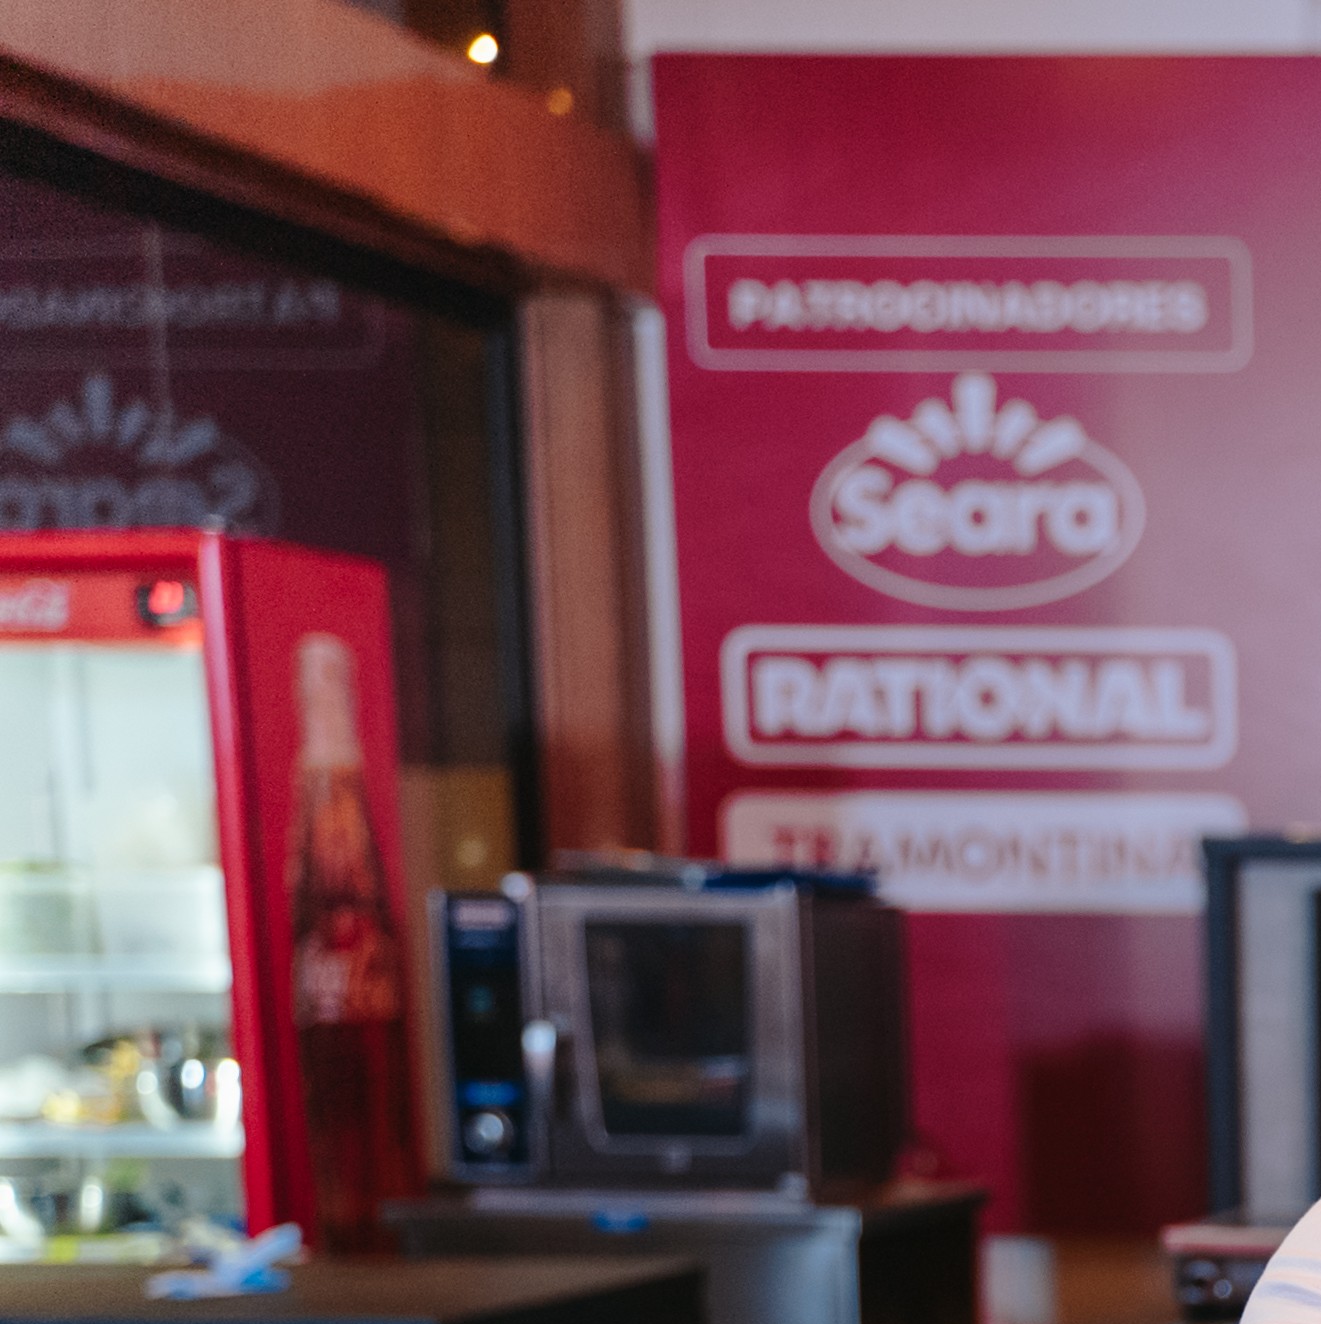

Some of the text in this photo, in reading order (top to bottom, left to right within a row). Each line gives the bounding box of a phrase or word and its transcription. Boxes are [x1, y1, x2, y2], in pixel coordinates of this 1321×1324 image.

[728, 278, 1208, 334] PATROCINADORES
[830, 464, 1121, 556] Seara
[750, 654, 1210, 739] RATIONAL
